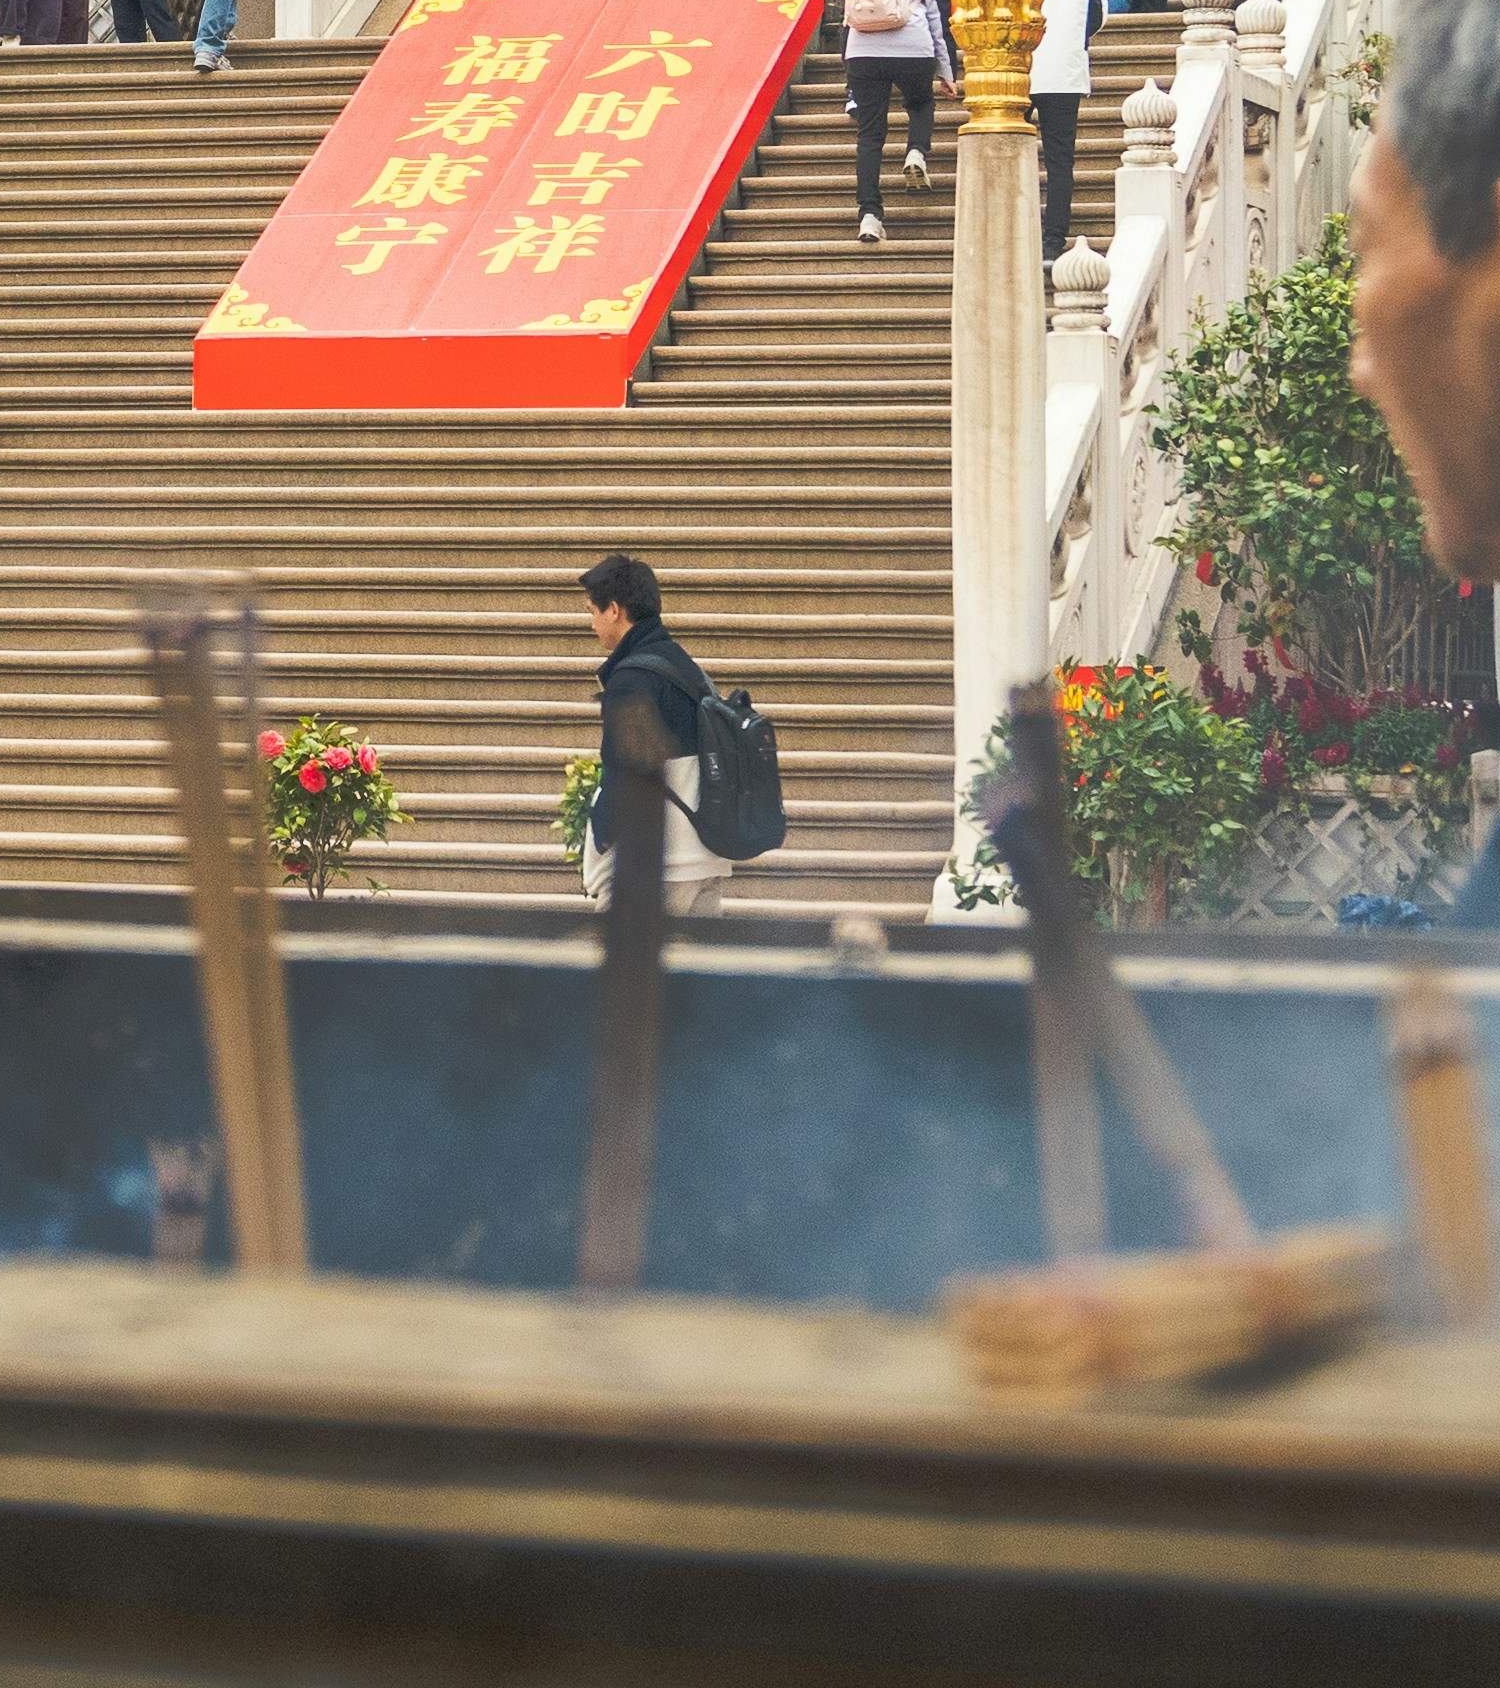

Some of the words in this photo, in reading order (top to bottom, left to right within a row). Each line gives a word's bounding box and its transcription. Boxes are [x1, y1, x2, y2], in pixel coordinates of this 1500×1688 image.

[335, 33, 565, 276] 福寿康宁
[478, 30, 713, 274] 六时吉祥
